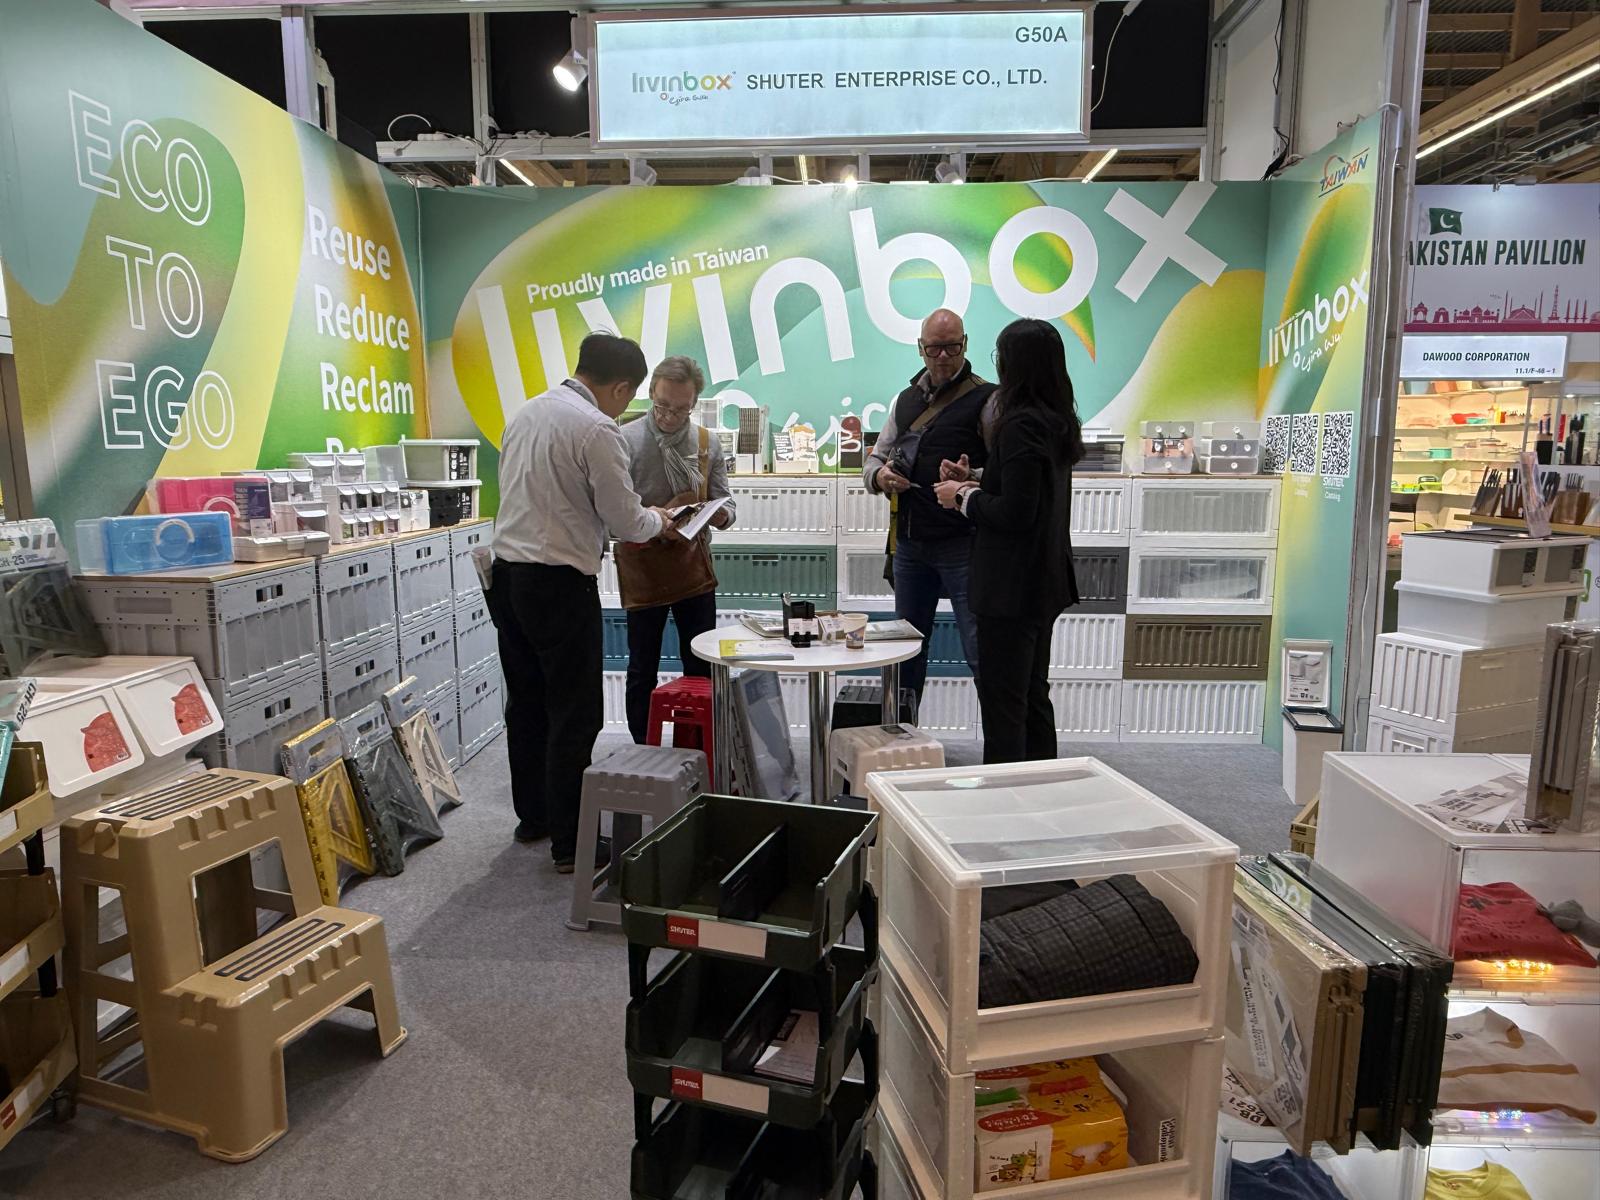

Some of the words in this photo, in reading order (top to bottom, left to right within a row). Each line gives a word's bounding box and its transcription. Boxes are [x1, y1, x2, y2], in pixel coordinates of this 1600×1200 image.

[1016, 26, 1068, 43] G50A
[632, 70, 732, 93] livinbox
[747, 72, 823, 90] SHUTER
[835, 69, 956, 88] ENTERPRISE
[962, 69, 1000, 88] CO.,
[1008, 68, 1047, 85] LTD.
[68, 90, 212, 226] ECO
[1320, 153, 1368, 191] TAIWAN
[307, 204, 391, 281] Reuse
[1408, 240, 1488, 266] KISTAN
[1494, 239, 1586, 265] PAVILION
[106, 235, 204, 339] TO
[477, 182, 1228, 424] livinbox
[527, 271, 604, 304] Proudly
[609, 261, 667, 288] made
[670, 256, 690, 277] in
[693, 245, 768, 271] Taiwan
[315, 286, 411, 351] Reduce
[1268, 271, 1369, 368] livinbox
[1423, 352, 1462, 362] DAWOOD
[1465, 351, 1530, 362] CORPORATION
[95, 359, 235, 450] EGO
[321, 362, 415, 415] Reclam
